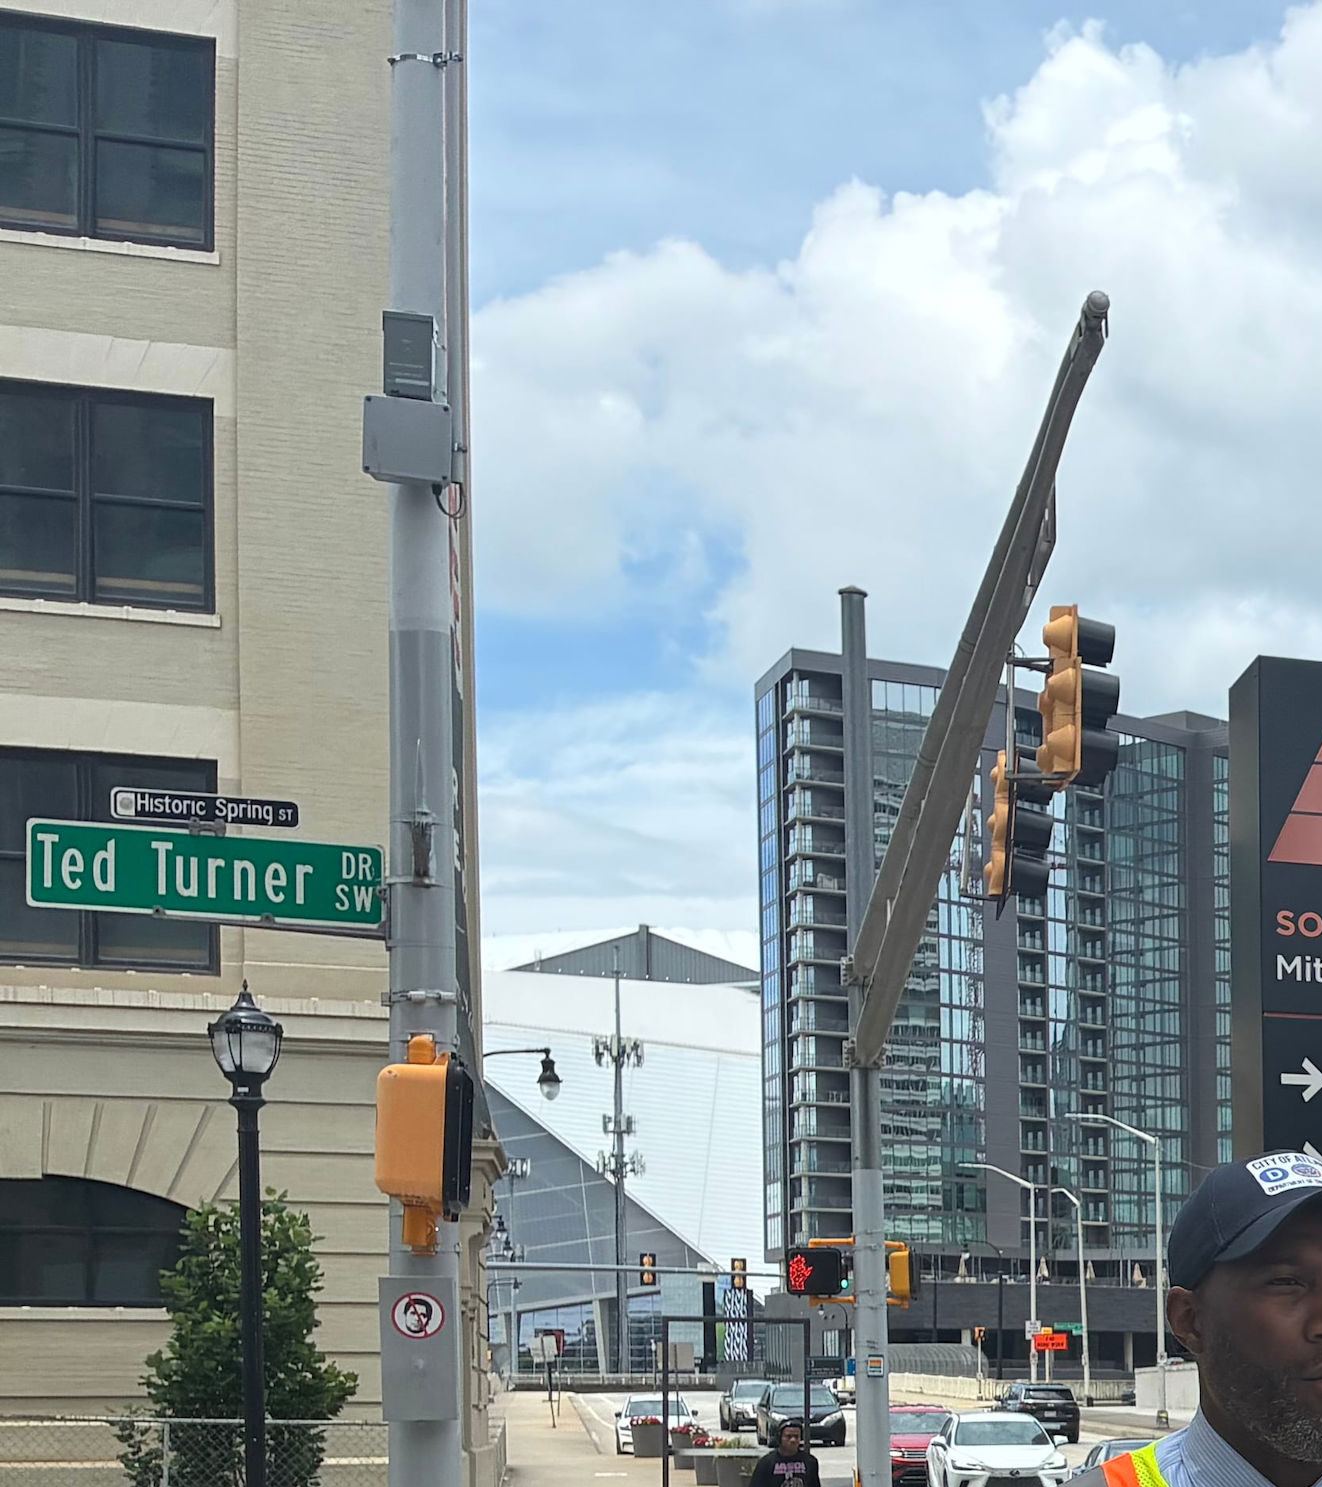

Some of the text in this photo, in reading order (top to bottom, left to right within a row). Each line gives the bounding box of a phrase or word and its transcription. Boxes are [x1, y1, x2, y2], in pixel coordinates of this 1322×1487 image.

[137, 793, 293, 827] Historic Spring ST
[36, 832, 374, 905] Ted Turner DR
[335, 884, 374, 913] SW
[1252, 1157, 1277, 1170] CITY
